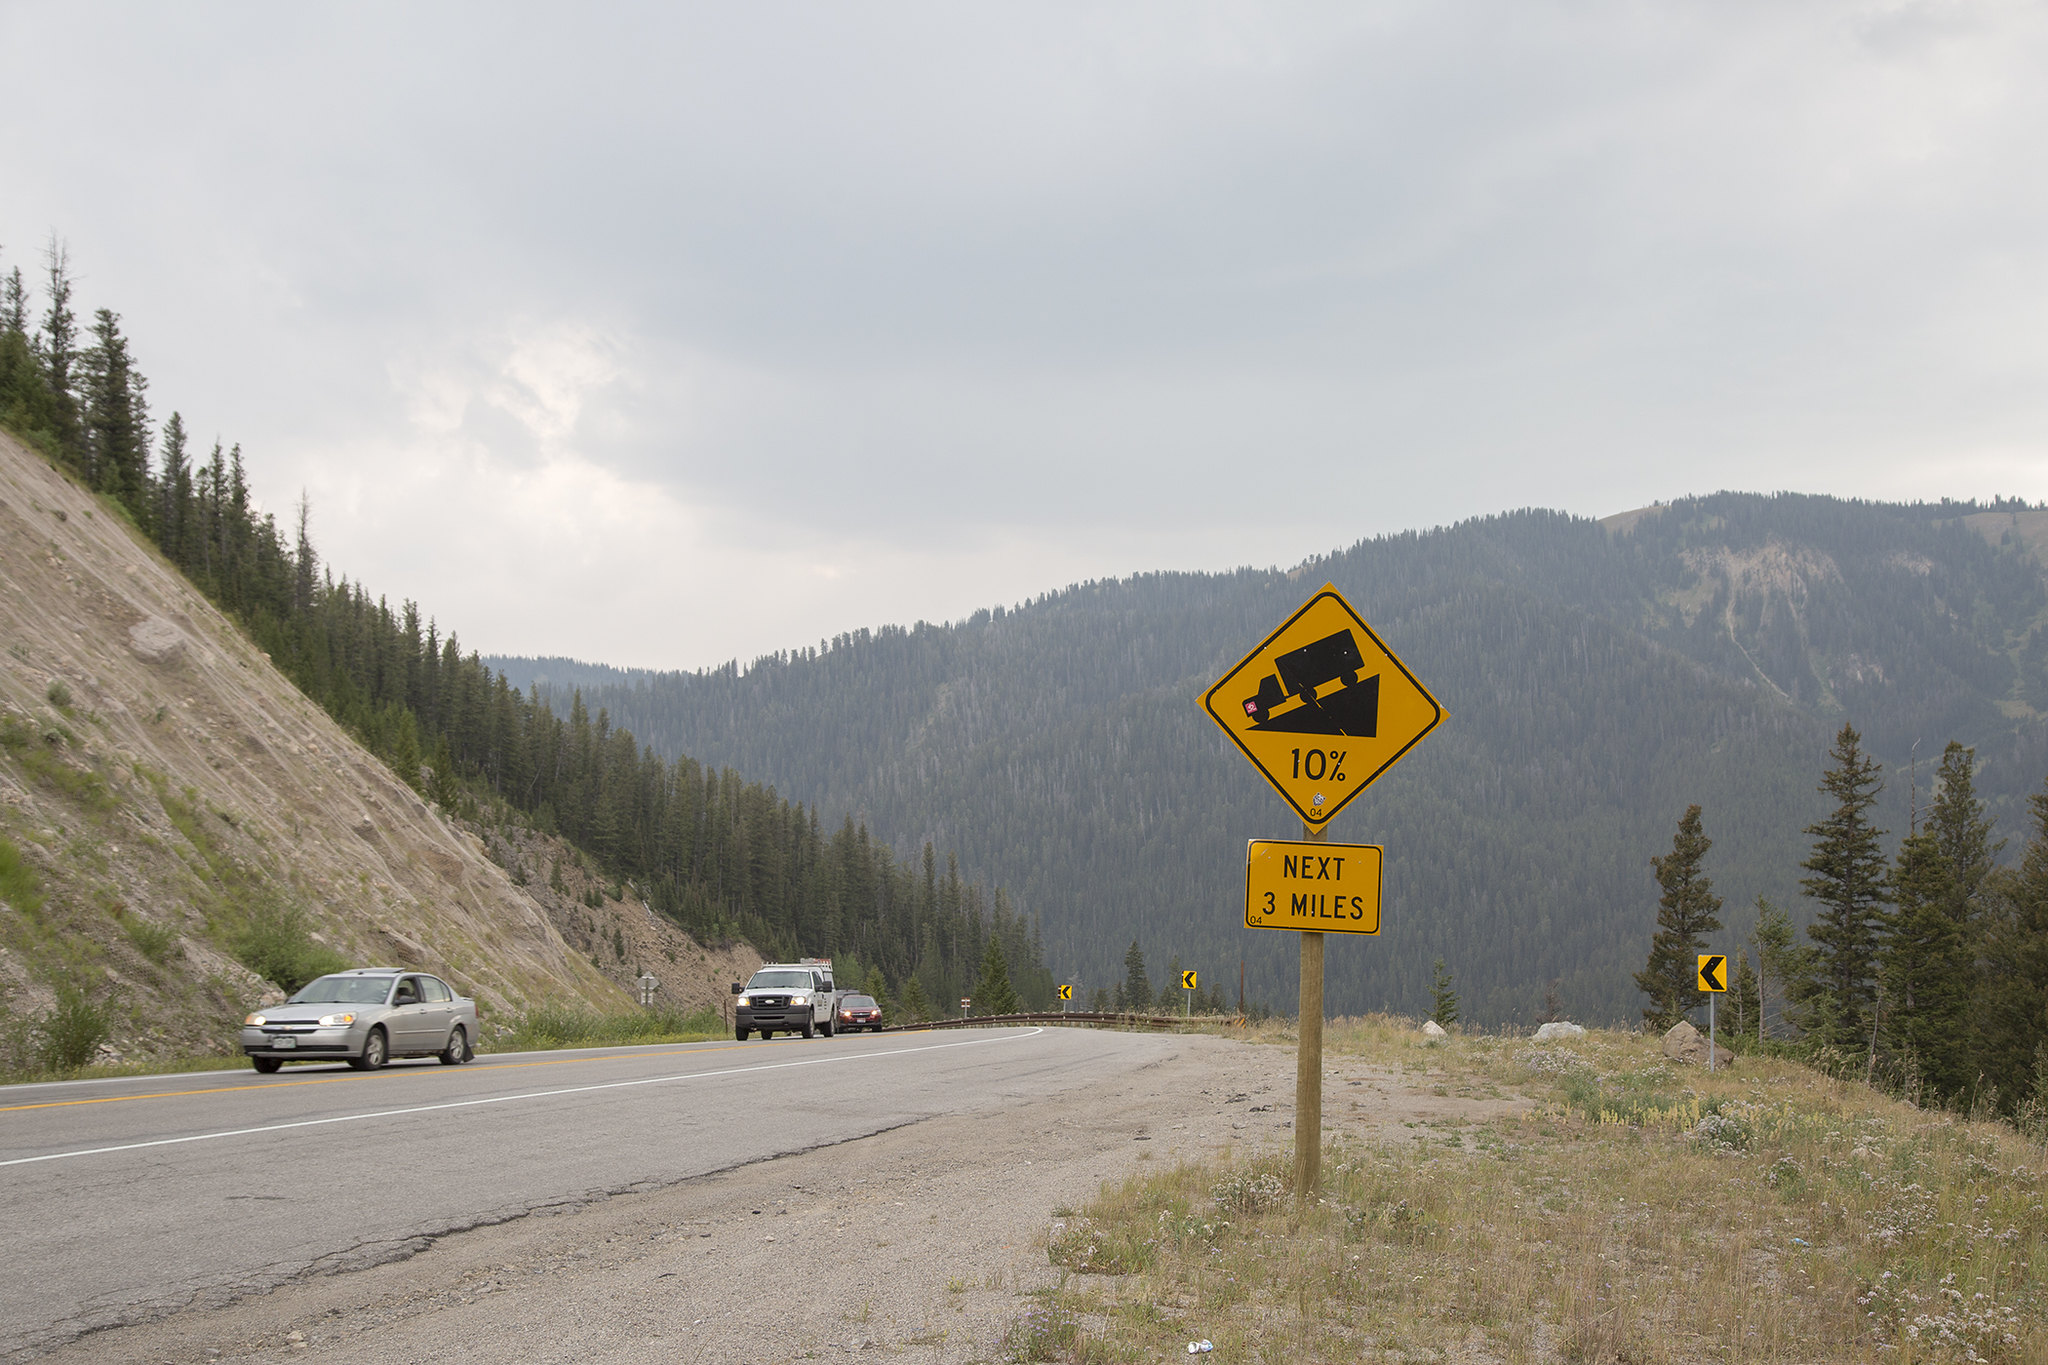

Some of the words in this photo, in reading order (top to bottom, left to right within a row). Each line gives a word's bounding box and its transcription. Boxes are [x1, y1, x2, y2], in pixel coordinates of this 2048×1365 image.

[1291, 748, 1347, 782] 10%
[1309, 807, 1322, 817] 04
[1283, 854, 1345, 881] NEXT
[1262, 891, 1276, 915] 3
[1291, 893, 1363, 920] MILES
[1249, 915, 1263, 925] 04
